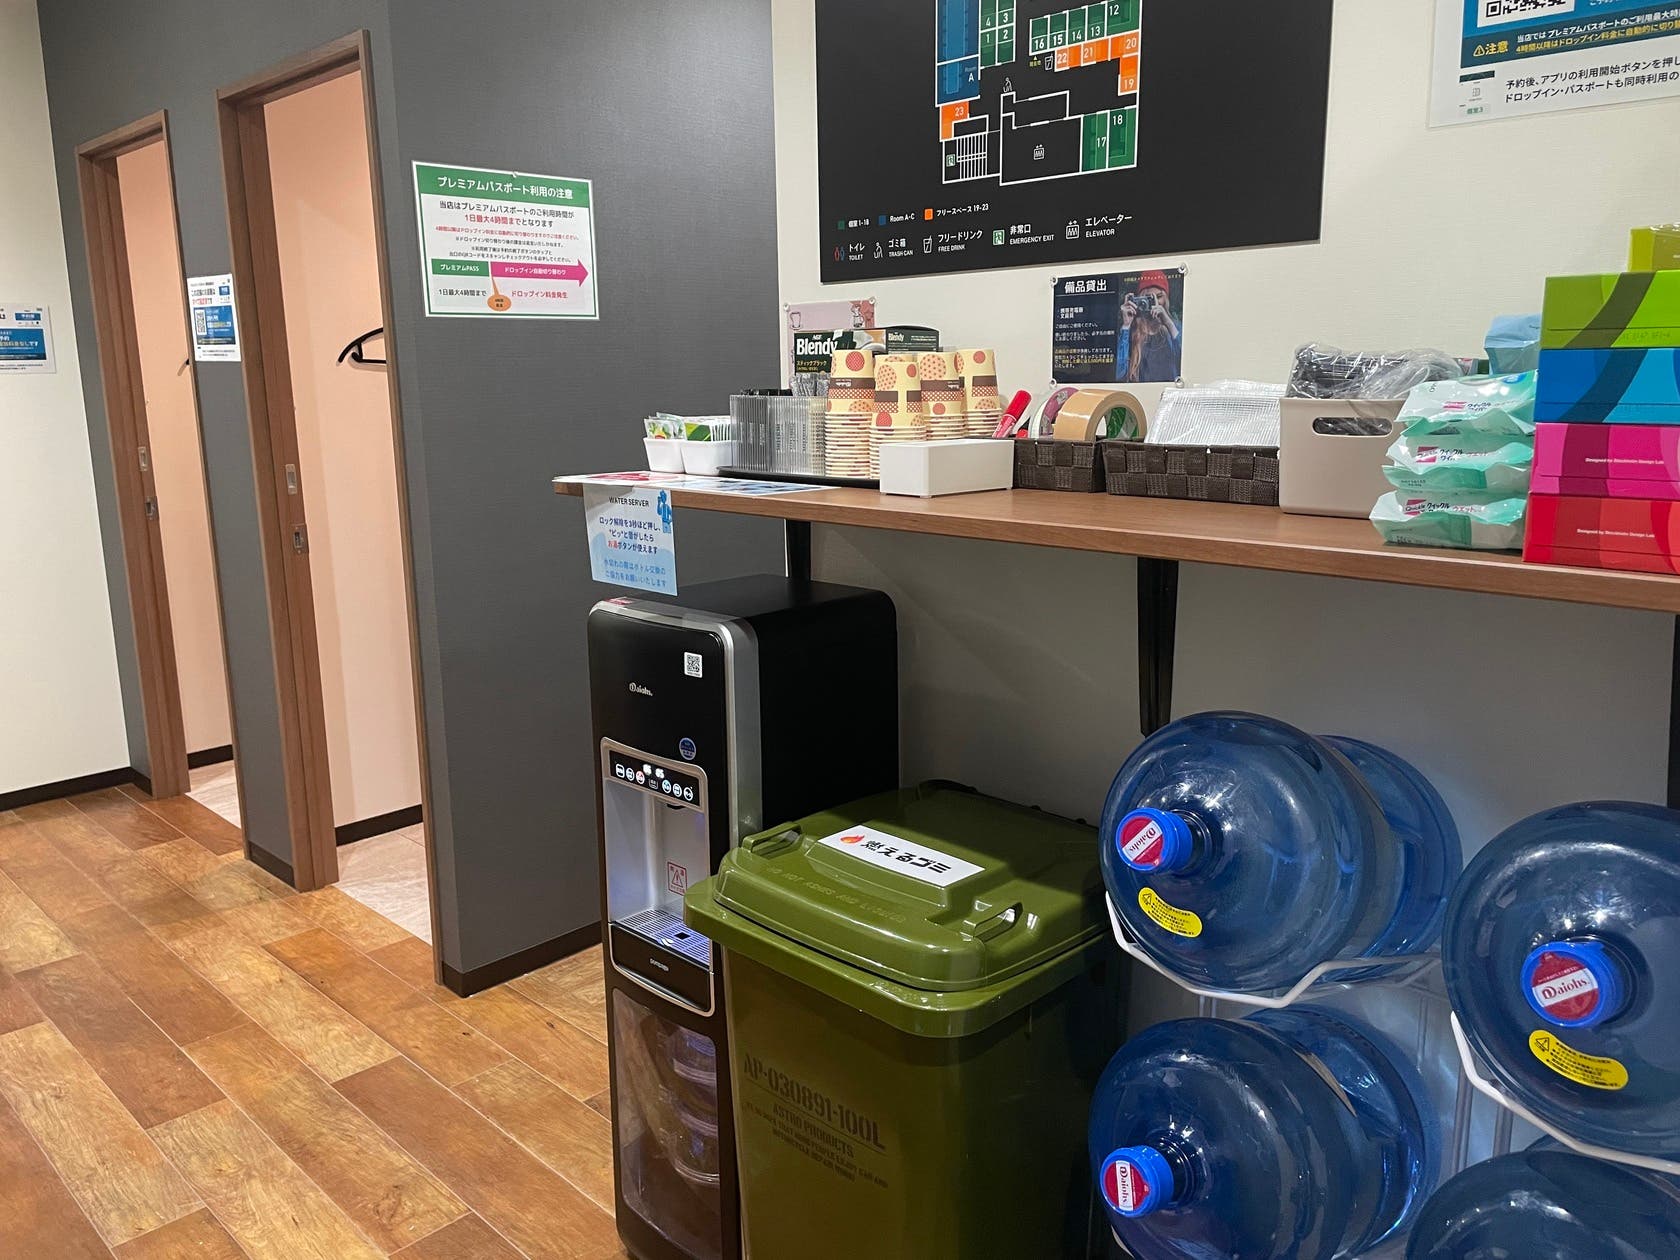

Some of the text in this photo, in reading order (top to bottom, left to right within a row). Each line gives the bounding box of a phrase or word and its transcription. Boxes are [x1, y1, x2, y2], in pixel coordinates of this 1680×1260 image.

[1108, 4, 1120, 16] 12
[1072, 30, 1082, 41] 14
[1090, 26, 1100, 37] 13
[1034, 39, 1045, 50] 16
[1053, 34, 1063, 46] 15
[1125, 38, 1137, 50] 20
[1084, 47, 1094, 58] 21
[1485, 40, 1509, 56] 注意
[1057, 53, 1068, 64] 22
[968, 72, 975, 82] A
[1124, 78, 1134, 89] 19
[954, 106, 964, 116] 23
[1112, 114, 1122, 126] 18
[1096, 136, 1107, 148] 17
[437, 176, 573, 200] プレミアムパスポート利用の注意
[439, 201, 575, 219] 当店はプレミアムパスポートのご利用時間が
[936, 203, 989, 216] フリースペース 19-23
[464, 214, 554, 228] 1日最大4時間までとなります
[890, 214, 904, 222] Room
[1085, 214, 1133, 227] エレベーター
[1010, 224, 1032, 235] 非常口
[1086, 228, 1115, 238] ELEVATOR
[938, 230, 983, 243] フリードリンク
[1010, 234, 1054, 245] EMERGENCY EXIT
[849, 242, 866, 252] トイレ
[950, 244, 966, 252] DRINK
[440, 263, 480, 272] プレミアムPASS
[438, 288, 487, 297] 1日最大4時間まで
[1064, 279, 1107, 294] 備品貸出
[511, 290, 568, 299] ドロップイン料金発生
[796, 337, 838, 356] Blendy
[608, 496, 650, 508] WATER SERVER
[1130, 827, 1156, 852] Daiohs
[860, 840, 952, 874] 燃えるゴミ
[1541, 976, 1588, 1000] Daiohs
[744, 1053, 886, 1150] AP-030891-100L
[774, 1104, 801, 1126] ASTRO
[803, 1118, 854, 1158] PRODUCTS
